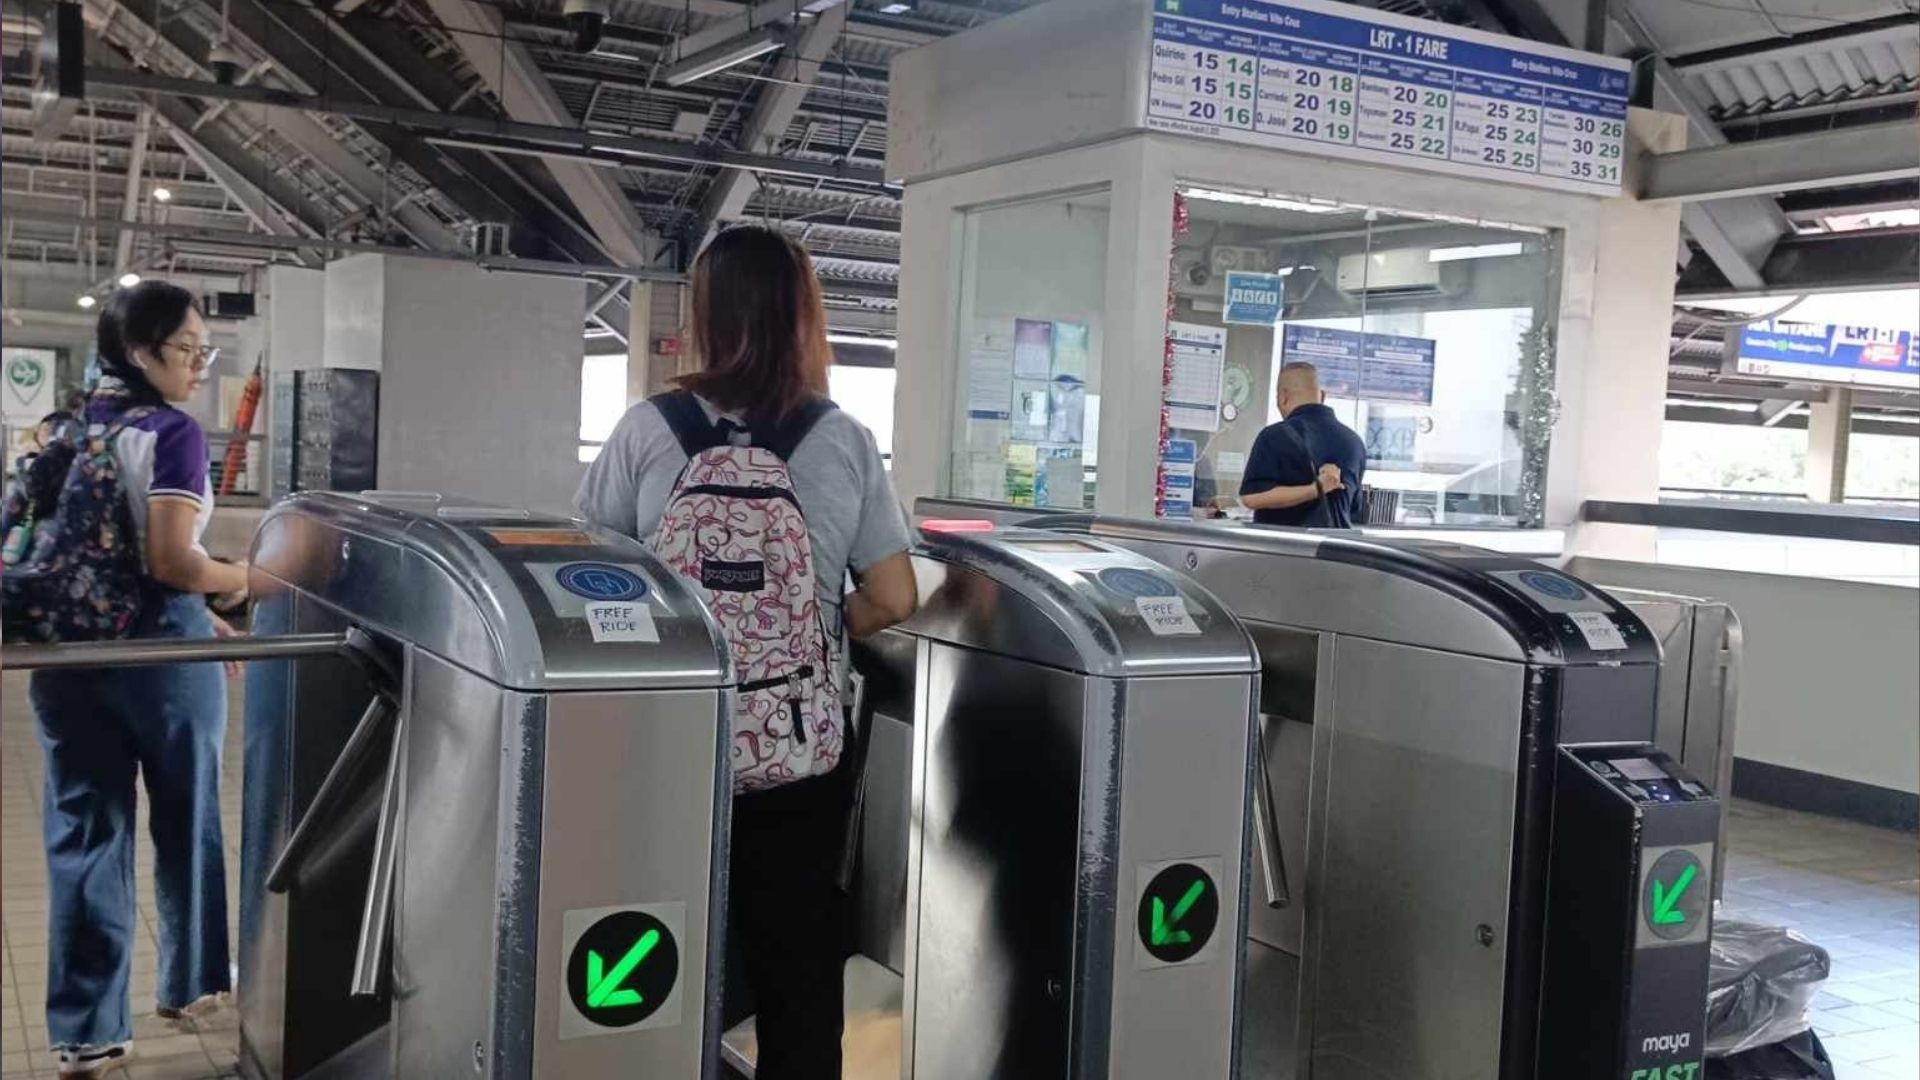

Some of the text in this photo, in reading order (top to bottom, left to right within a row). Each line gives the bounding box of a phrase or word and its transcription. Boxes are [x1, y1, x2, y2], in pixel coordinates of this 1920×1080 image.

[1369, 28, 1395, 49] LRT
[1405, 34, 1413, 54] 1
[1415, 36, 1449, 60] FARE
[1193, 51, 1219, 70] 15
[1226, 57, 1253, 77] 14
[1191, 76, 1217, 95] 15
[1225, 81, 1251, 100] 15
[1295, 68, 1321, 88] 20
[1328, 75, 1353, 93] 18
[1293, 92, 1319, 111] 20
[1327, 98, 1352, 116] 19
[1393, 86, 1418, 104] 20
[1423, 91, 1448, 109] 20
[1188, 100, 1216, 119] 20
[1224, 106, 1250, 125] 16
[1392, 108, 1416, 127] 25
[1422, 114, 1445, 131] 21
[1486, 102, 1509, 119] 25
[1515, 107, 1538, 124] 23
[1292, 117, 1318, 135] 20
[1325, 122, 1350, 140] 19
[1485, 124, 1508, 141] 25
[1513, 129, 1536, 146] 24
[1573, 116, 1595, 133] 30
[1600, 121, 1622, 138] 26
[1390, 132, 1415, 150] 25
[1420, 137, 1445, 155] 22
[1572, 138, 1593, 155] 30
[1598, 143, 1620, 158] 29
[1483, 147, 1506, 164] 25
[1512, 151, 1535, 168] 25
[1571, 161, 1592, 177] 35
[1597, 165, 1617, 181] 31
[592, 606, 633, 619] FREE
[1143, 602, 1175, 615] FREE
[600, 620, 637, 633] RIDE
[1642, 1032, 1691, 1054] maya
